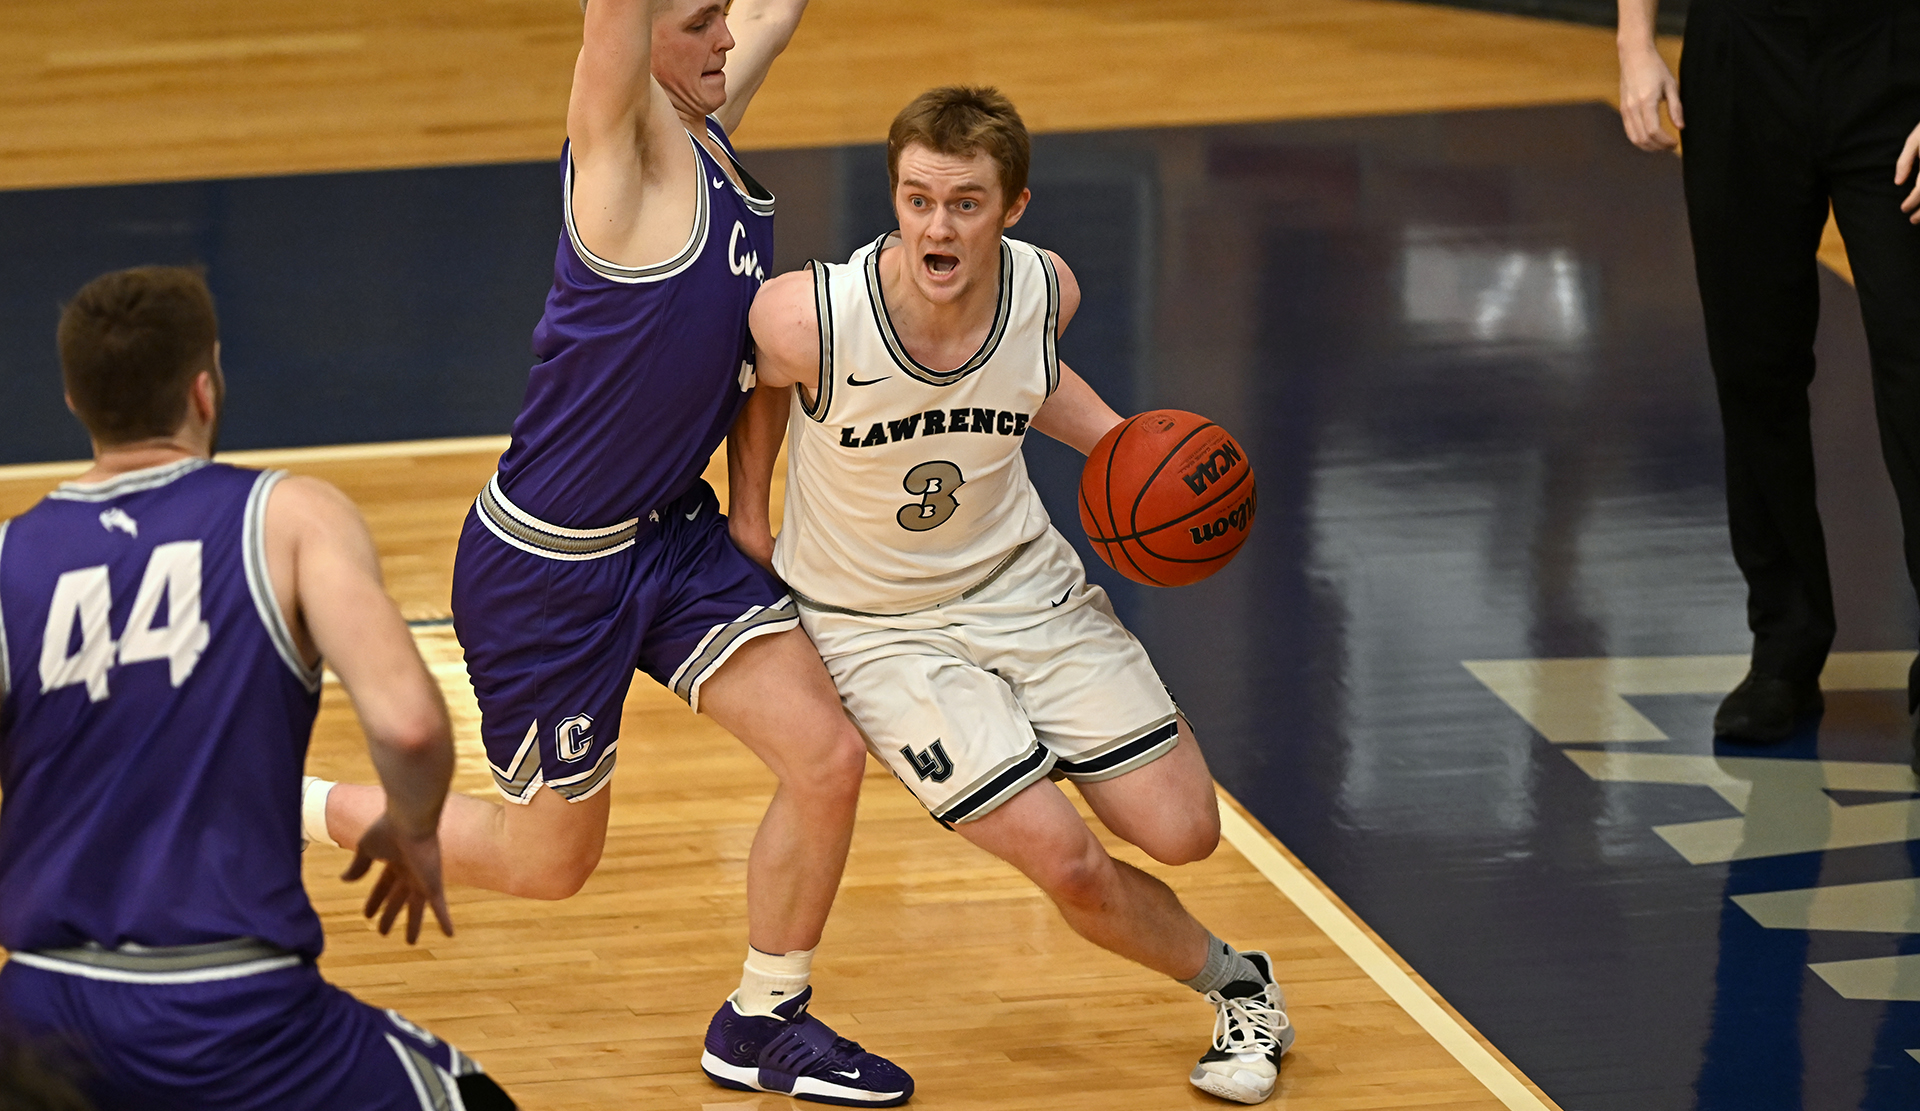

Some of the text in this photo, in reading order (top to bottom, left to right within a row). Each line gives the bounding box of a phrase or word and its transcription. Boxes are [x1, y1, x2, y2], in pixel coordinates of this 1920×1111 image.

[839, 407, 1030, 448] LAWRENCE
[896, 460, 966, 532] 3
[1182, 440, 1242, 496] NCAA
[38, 539, 210, 703] 44
[555, 712, 595, 764] C
